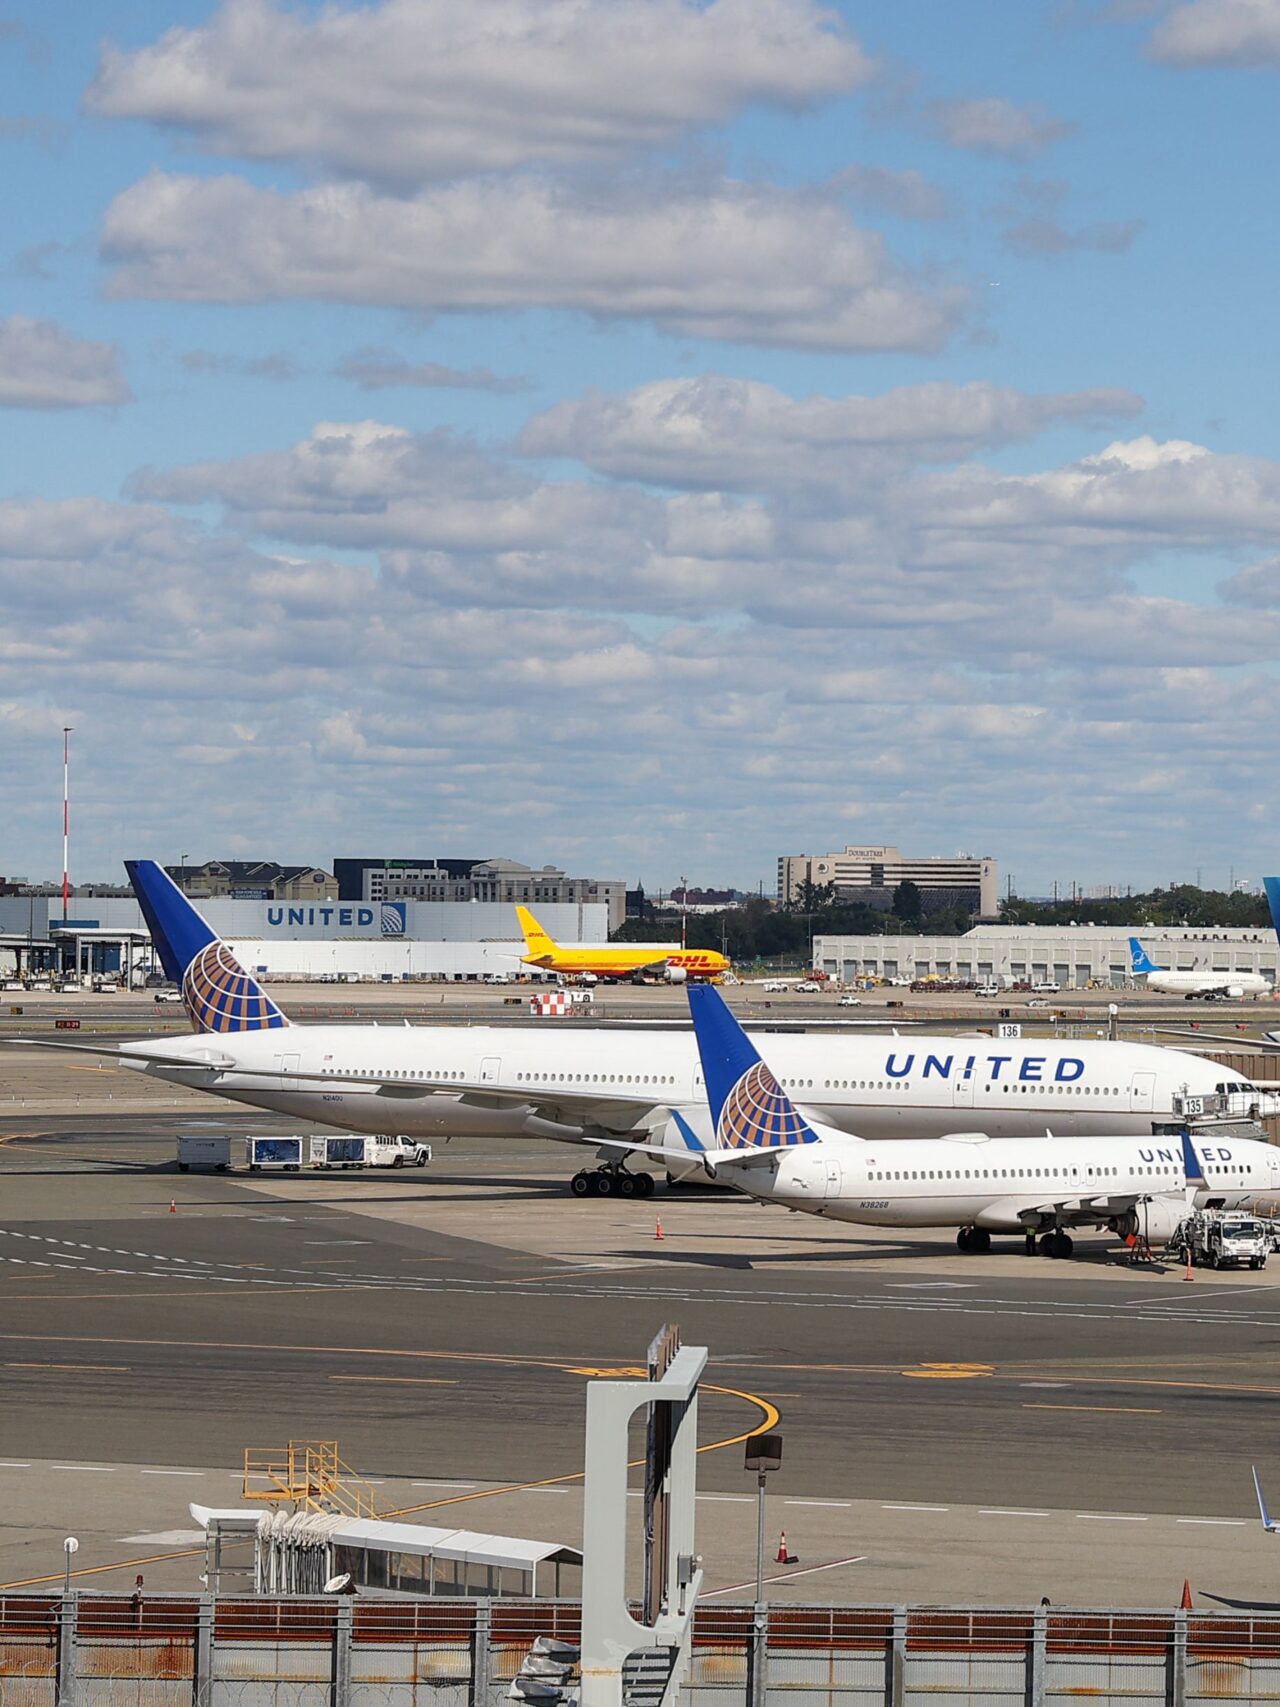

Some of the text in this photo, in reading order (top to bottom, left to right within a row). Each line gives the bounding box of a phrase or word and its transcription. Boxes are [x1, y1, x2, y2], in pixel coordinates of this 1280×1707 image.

[267, 907, 374, 926] UNITED
[666, 956, 711, 967] DHL
[1002, 1025, 1018, 1037] 136
[885, 1054, 1085, 1082] UNITED
[1186, 1099, 1201, 1113] 135
[1138, 1148, 1232, 1162] UNIED
